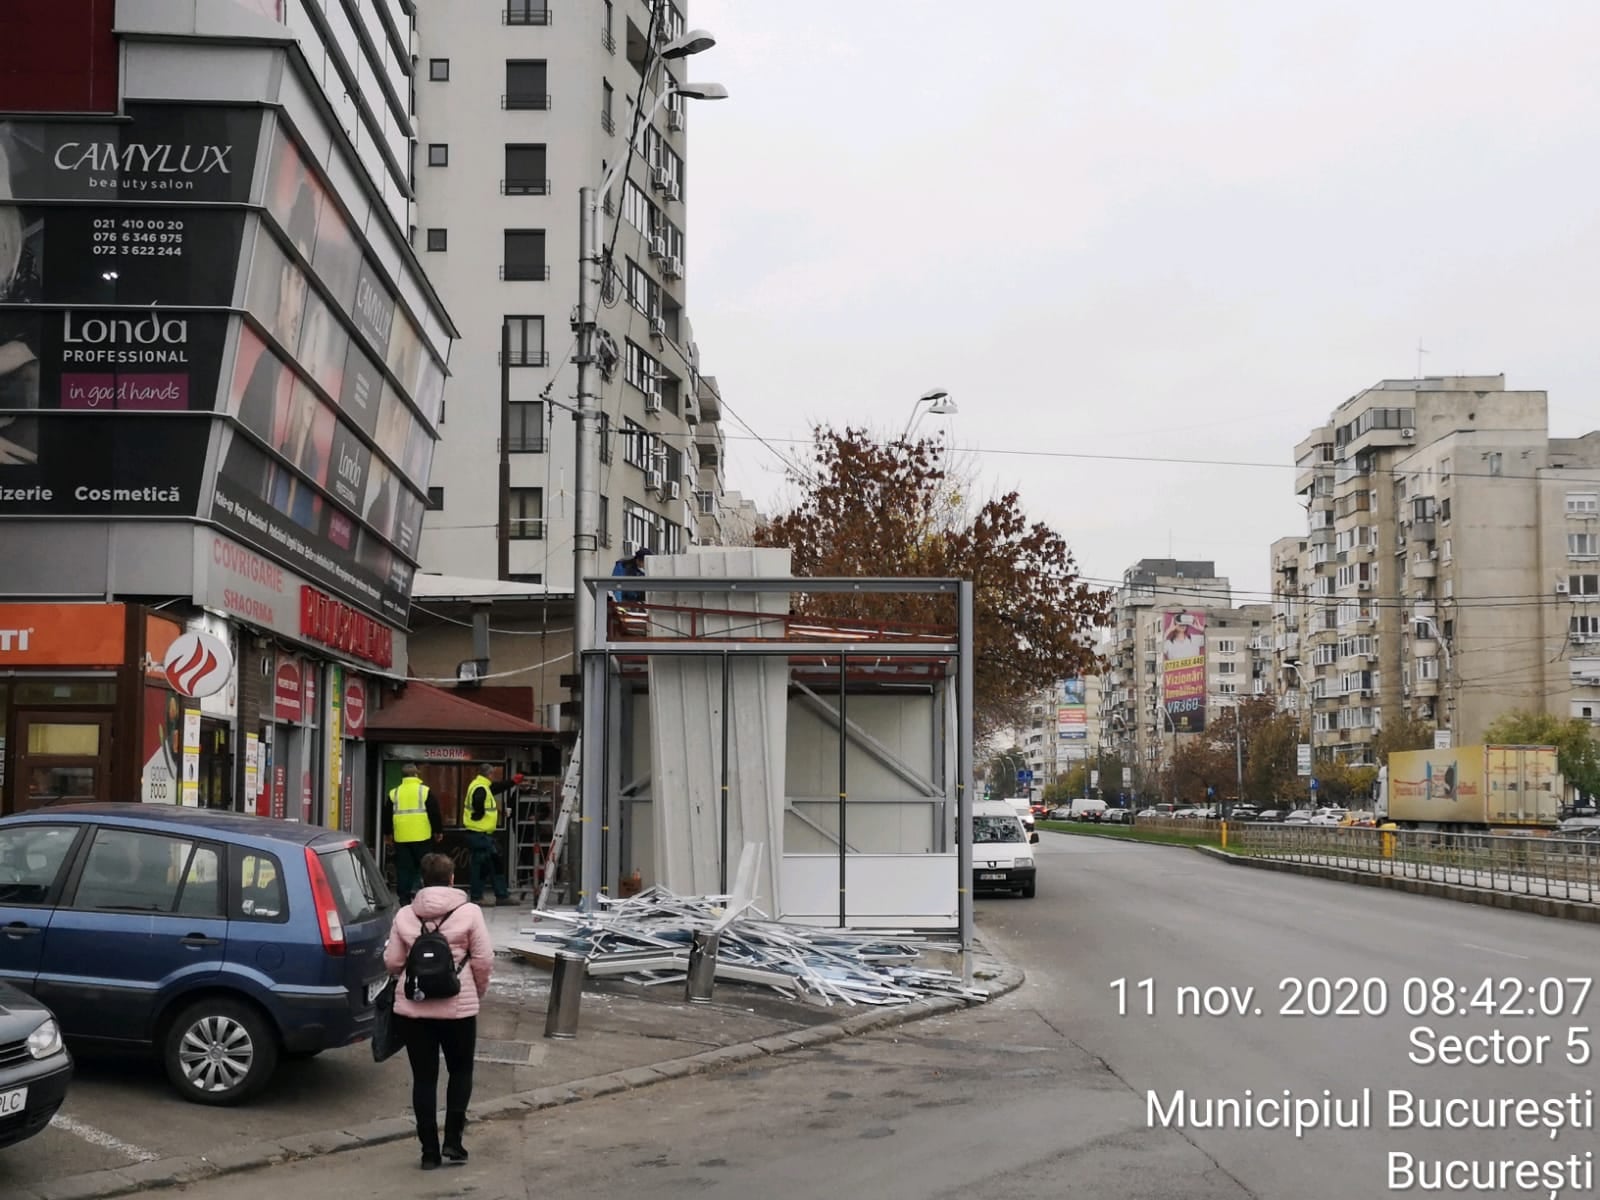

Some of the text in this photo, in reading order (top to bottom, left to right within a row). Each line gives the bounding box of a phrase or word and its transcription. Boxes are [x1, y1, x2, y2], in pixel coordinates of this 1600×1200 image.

[54, 142, 233, 174] CAMYLUX
[93, 219, 184, 231] 021 410 00 20
[63, 301, 188, 344] Londa
[63, 350, 189, 363] PROFESSIONAL
[69, 381, 180, 408] in good hands
[74, 485, 180, 502] Cosmetică
[213, 537, 284, 594] COVRIGARIE
[223, 588, 274, 625] SHAORMA
